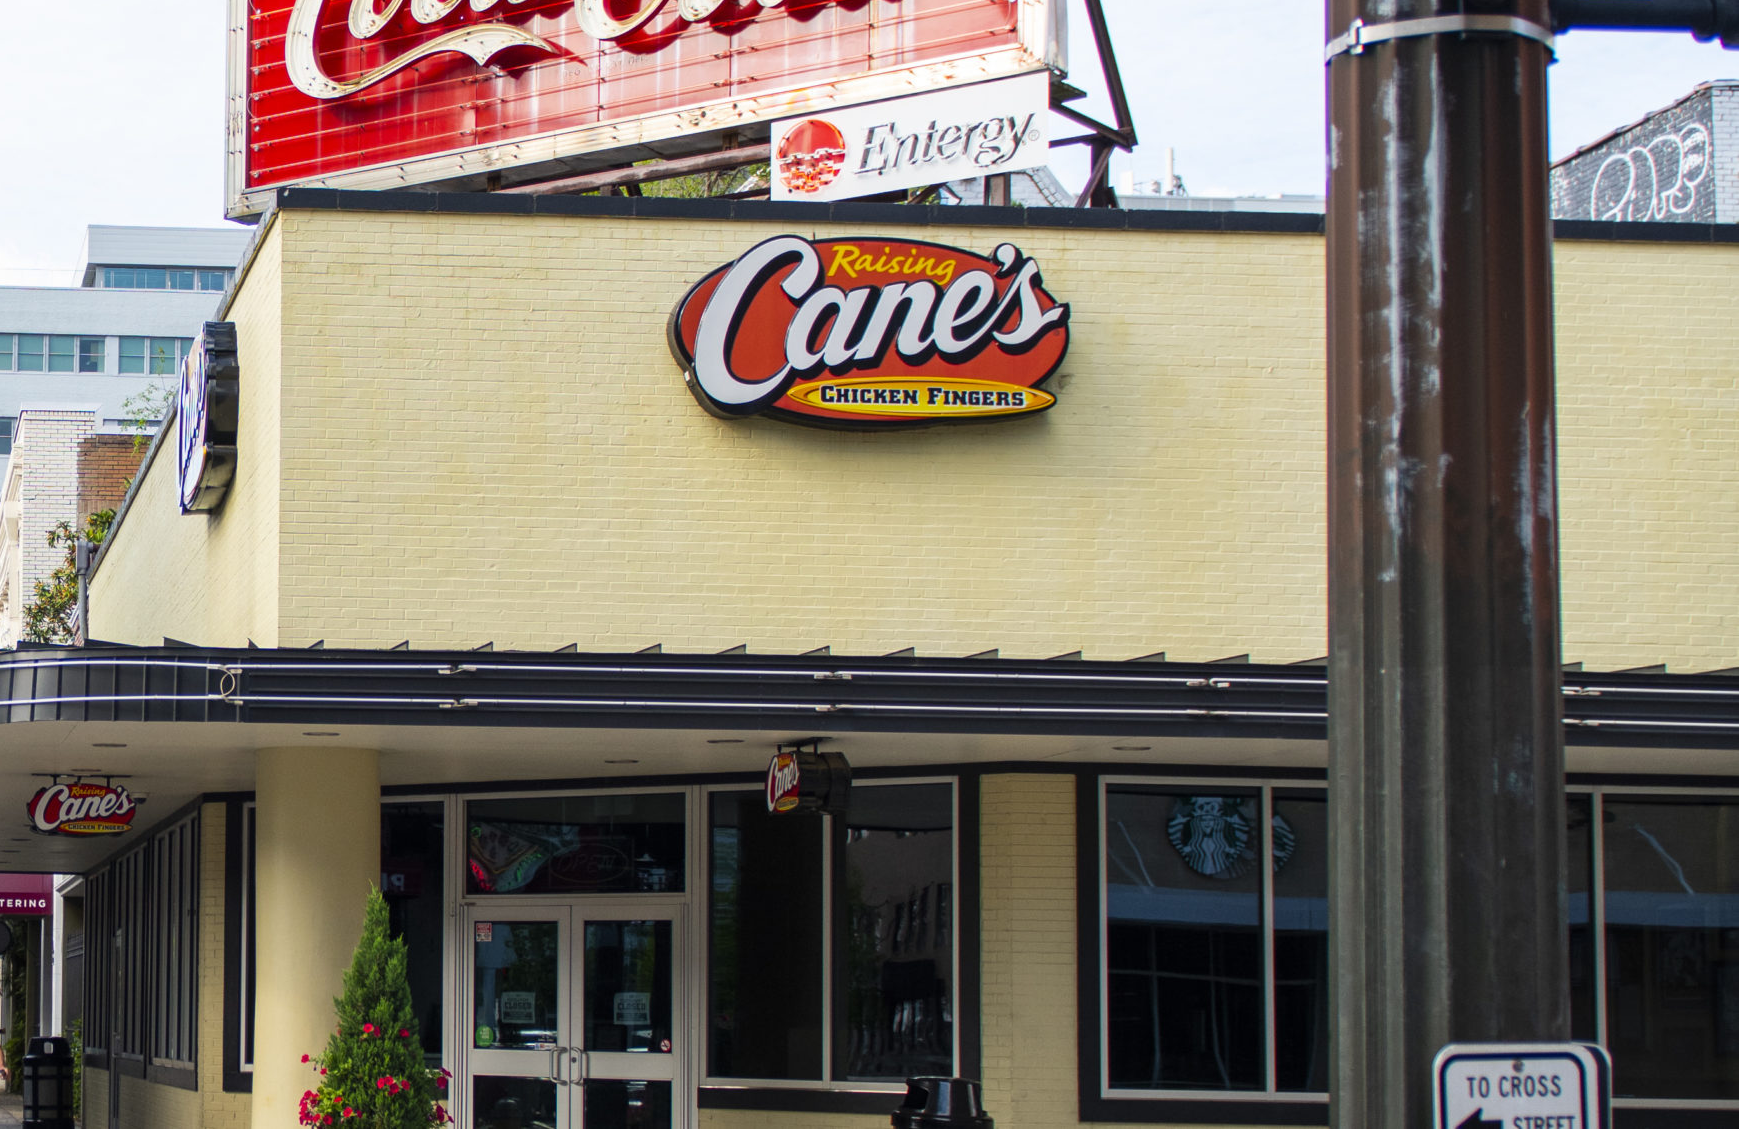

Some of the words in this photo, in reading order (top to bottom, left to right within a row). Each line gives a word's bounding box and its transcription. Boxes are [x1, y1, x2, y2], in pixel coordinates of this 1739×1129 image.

[854, 113, 1036, 176] Entergy
[828, 245, 957, 286] Raising
[695, 236, 1064, 405] Cane's
[820, 384, 919, 406] CHICKEN
[927, 387, 1025, 408] FINGERS
[34, 784, 135, 831] Cane's
[71, 787, 106, 798] Raising
[1467, 1076, 1491, 1098] TO
[1499, 1075, 1562, 1098] CROSS
[1513, 1115, 1576, 1129] STREET
